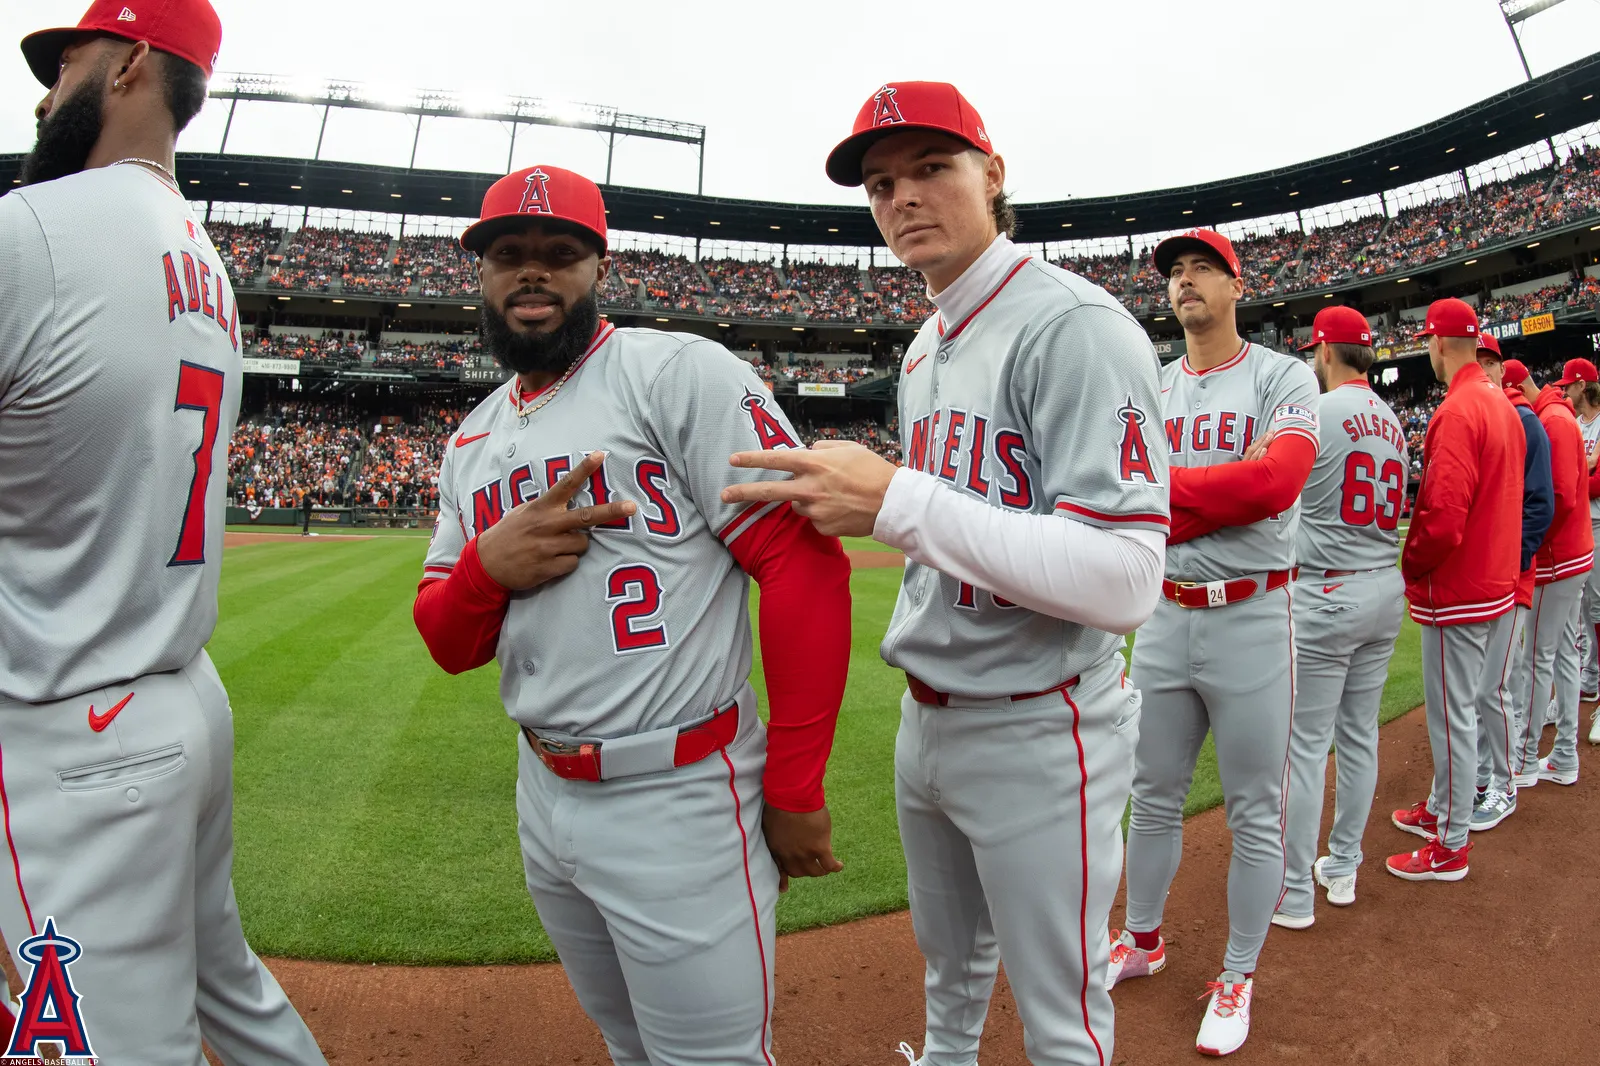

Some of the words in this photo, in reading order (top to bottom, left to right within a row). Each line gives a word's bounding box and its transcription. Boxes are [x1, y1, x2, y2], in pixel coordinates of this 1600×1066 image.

[873, 84, 906, 127] A
[518, 168, 553, 214] A
[162, 251, 239, 352] ADELL
[1523, 316, 1551, 333] SEASON
[464, 370, 495, 380] SHIFT
[739, 382, 806, 451] A
[1115, 393, 1164, 487] A
[1165, 410, 1257, 456] NGEL
[1342, 412, 1405, 454] SILSETH
[166, 359, 225, 567] 7
[908, 406, 1034, 513] NGELS
[1340, 450, 1404, 531] 63
[458, 450, 683, 541] NGLS
[605, 562, 670, 656] 2
[1210, 588, 1224, 603] 24
